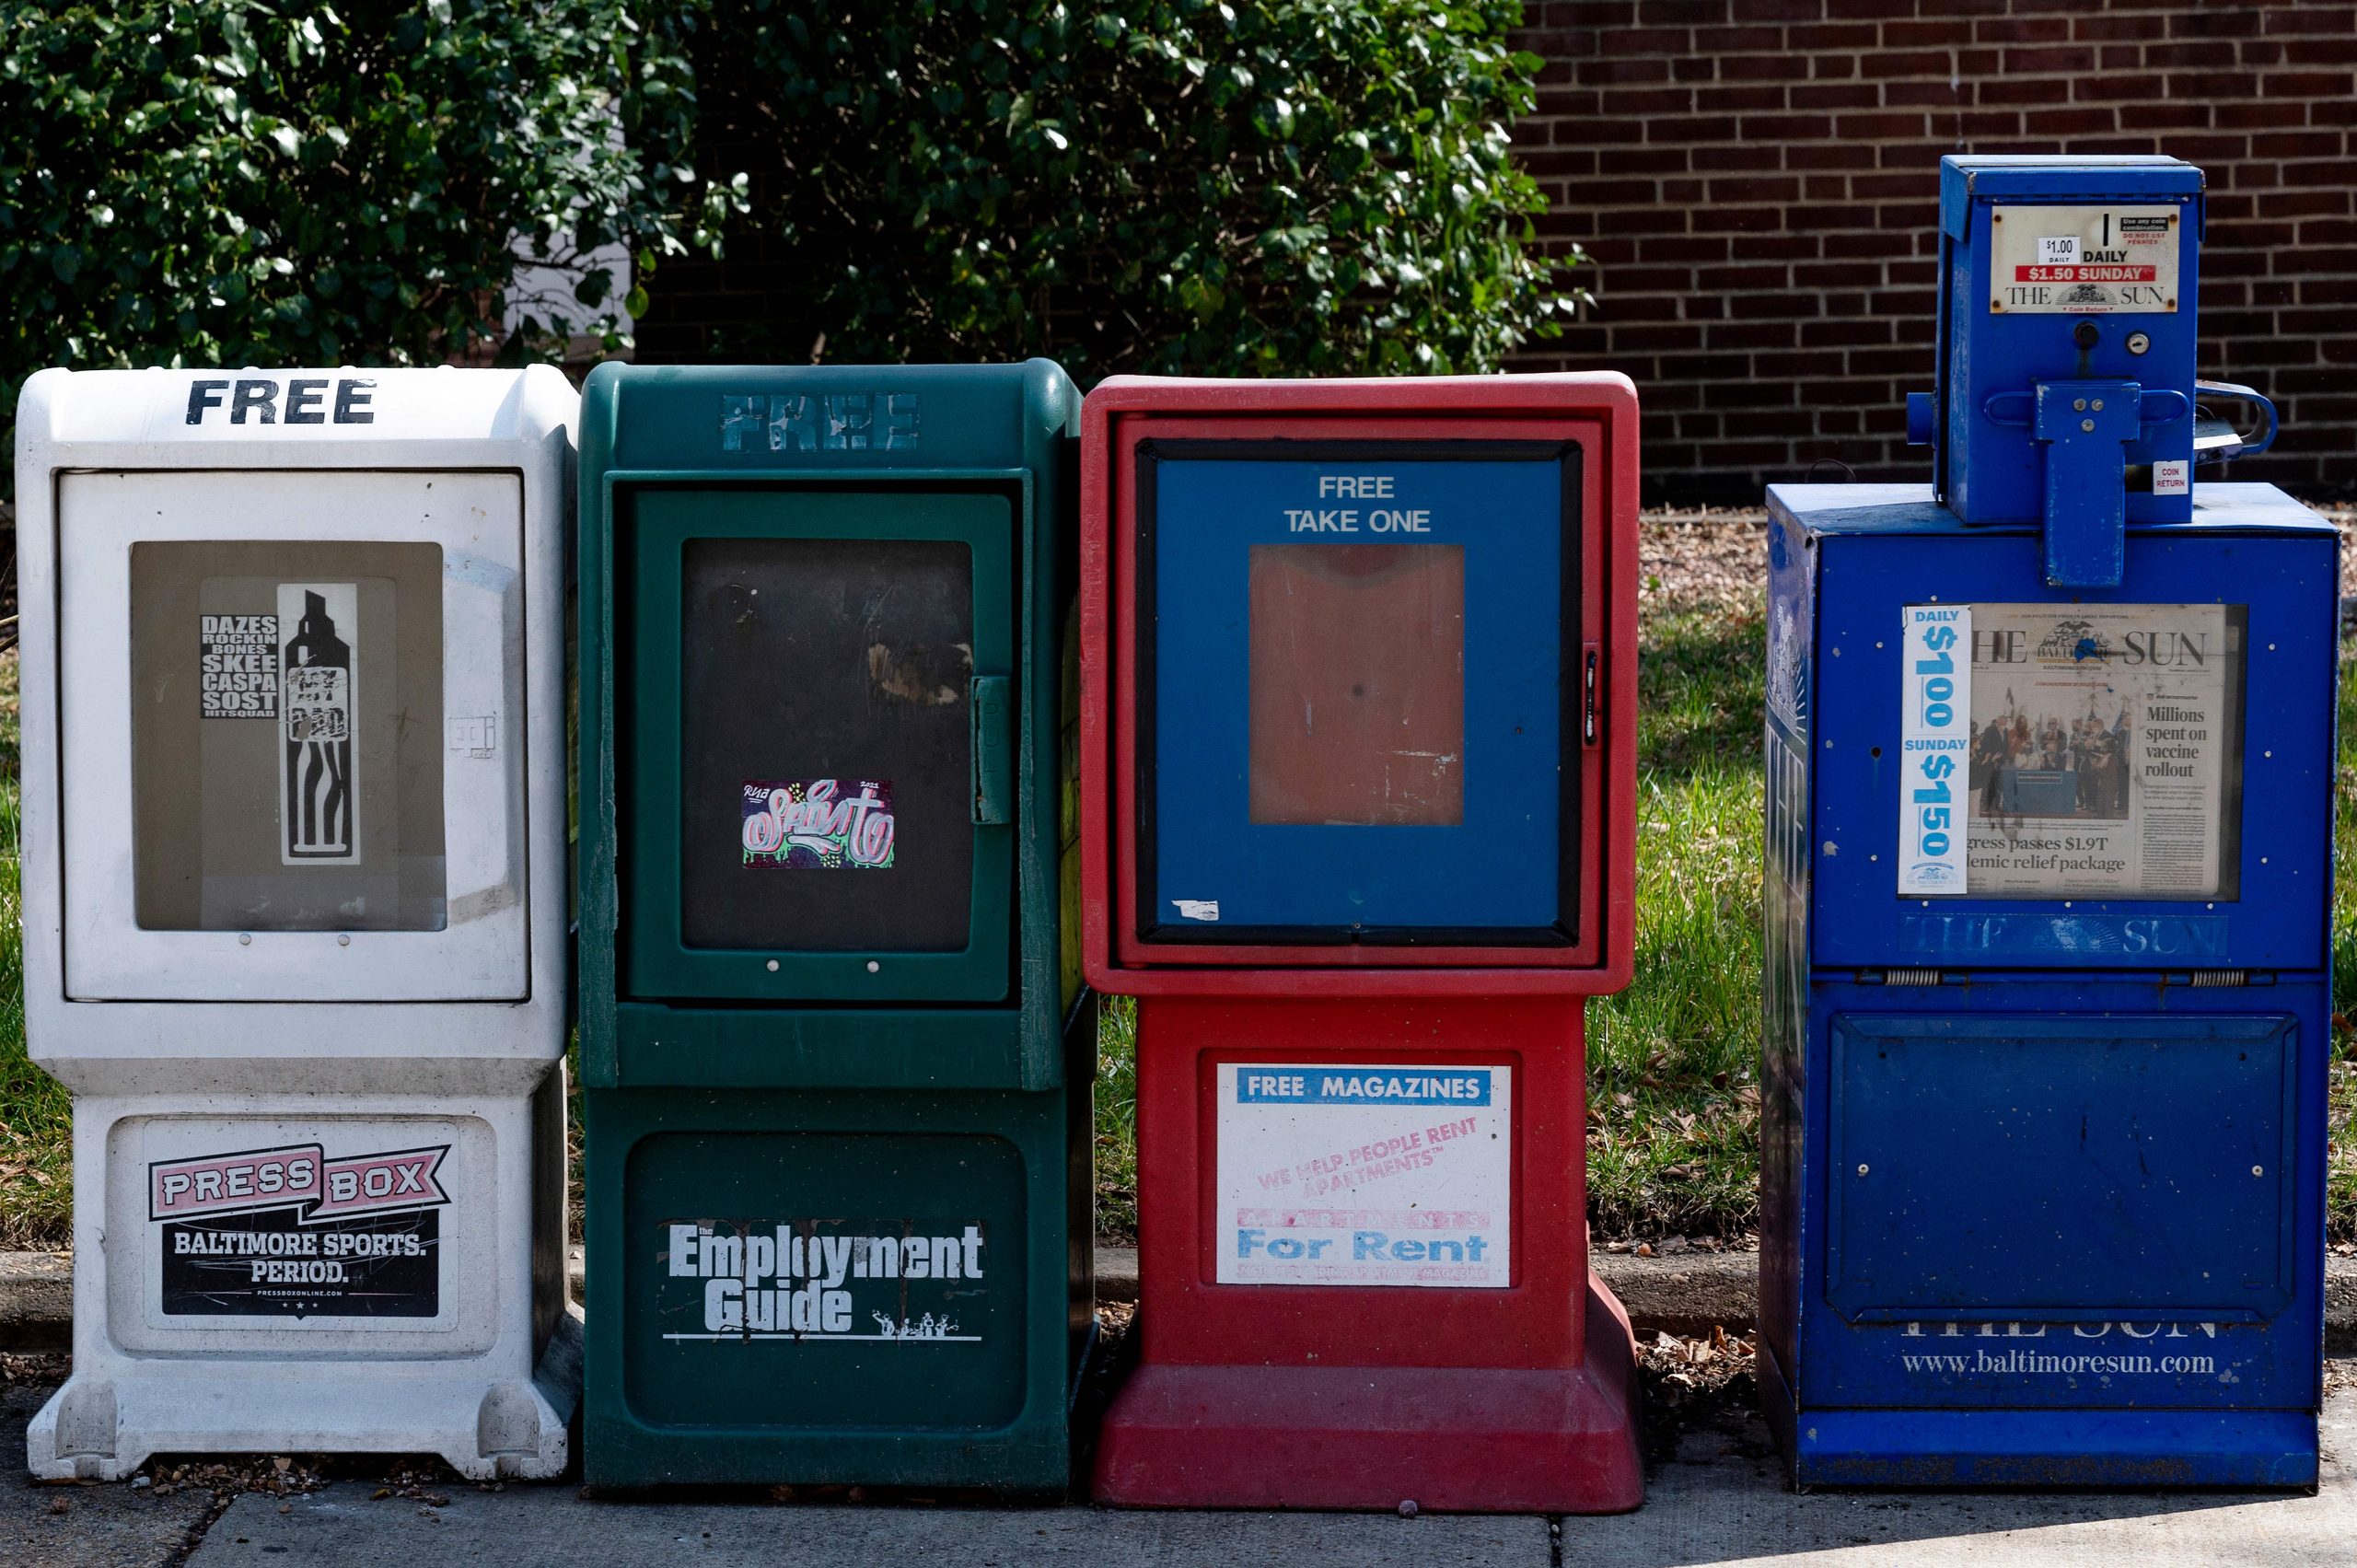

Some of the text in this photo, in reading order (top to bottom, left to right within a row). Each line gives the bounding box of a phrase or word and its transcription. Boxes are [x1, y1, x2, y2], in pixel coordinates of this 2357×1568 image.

[2047, 239, 2073, 254] $1.00
[2083, 250, 2128, 262] DAILY
[2028, 267, 2074, 281] $1.50
[2078, 267, 2142, 280] SUNDAY
[2005, 286, 2165, 305] THE SUN
[186, 379, 377, 424] FREE
[723, 393, 919, 451] FREE
[2162, 468, 2179, 476] COIN
[1319, 476, 1395, 498] FREE
[2156, 479, 2185, 487] RETURN
[1283, 510, 1431, 533] TAKE ONE
[202, 616, 277, 634] DAZES
[1915, 610, 1960, 622] DAILY
[202, 633, 277, 645] ROCKIN
[212, 645, 267, 655] BONES
[2123, 631, 2209, 667] SUN
[202, 654, 277, 673] SKEE
[202, 673, 277, 691] CASPA
[202, 691, 277, 710] SOST
[2147, 706, 2205, 723] Millions
[2146, 727, 2207, 743] spent on
[1904, 739, 1967, 751] SUNDAY
[2146, 743, 2200, 759] vaccine
[2145, 761, 2195, 777] rollout
[2010, 839, 2061, 853] passes
[2065, 837, 2108, 852] $1.9T
[2014, 854, 2059, 870] relief
[2060, 855, 2126, 874] package
[1248, 1076, 1480, 1098] FREE MAGAZINES
[1257, 1117, 1477, 1191] WE HELP PEOPLE RENT
[162, 1158, 426, 1205] PRESS BOX
[699, 1226, 714, 1235] the
[174, 1232, 426, 1257] BALTIMORE SPORTS.
[1237, 1229, 1488, 1262] For Rent
[669, 1224, 983, 1288] Employment
[251, 1260, 349, 1283] PERIOD.
[704, 1278, 853, 1332] Guide
[1901, 1349, 2215, 1375] www.baltimoresun.com
